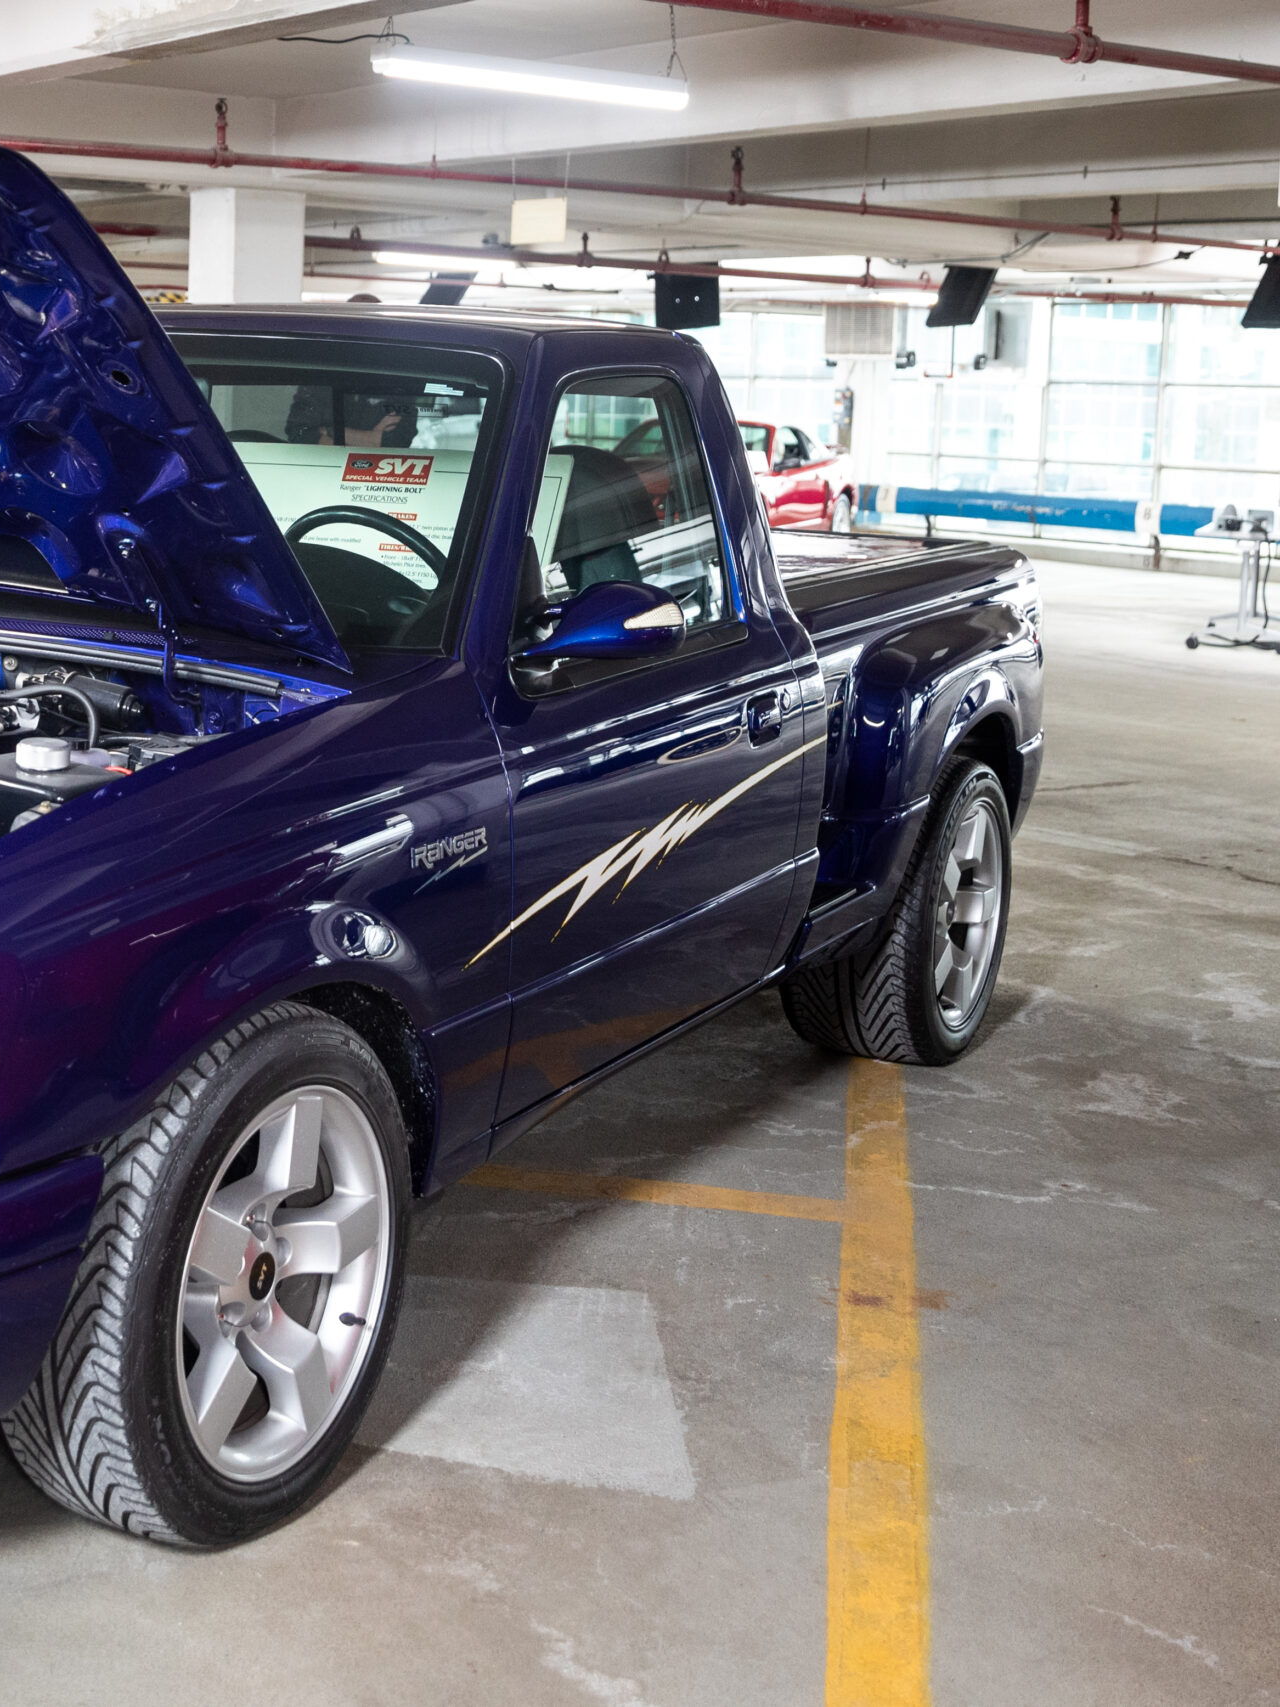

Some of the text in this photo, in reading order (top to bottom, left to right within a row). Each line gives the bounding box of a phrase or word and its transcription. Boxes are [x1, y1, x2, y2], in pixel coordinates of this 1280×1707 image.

[374, 458, 430, 476] SVT
[340, 484, 362, 492] Ranger
[351, 494, 408, 504] SPECIFICATIONS
[410, 825, 488, 870] RANGER
